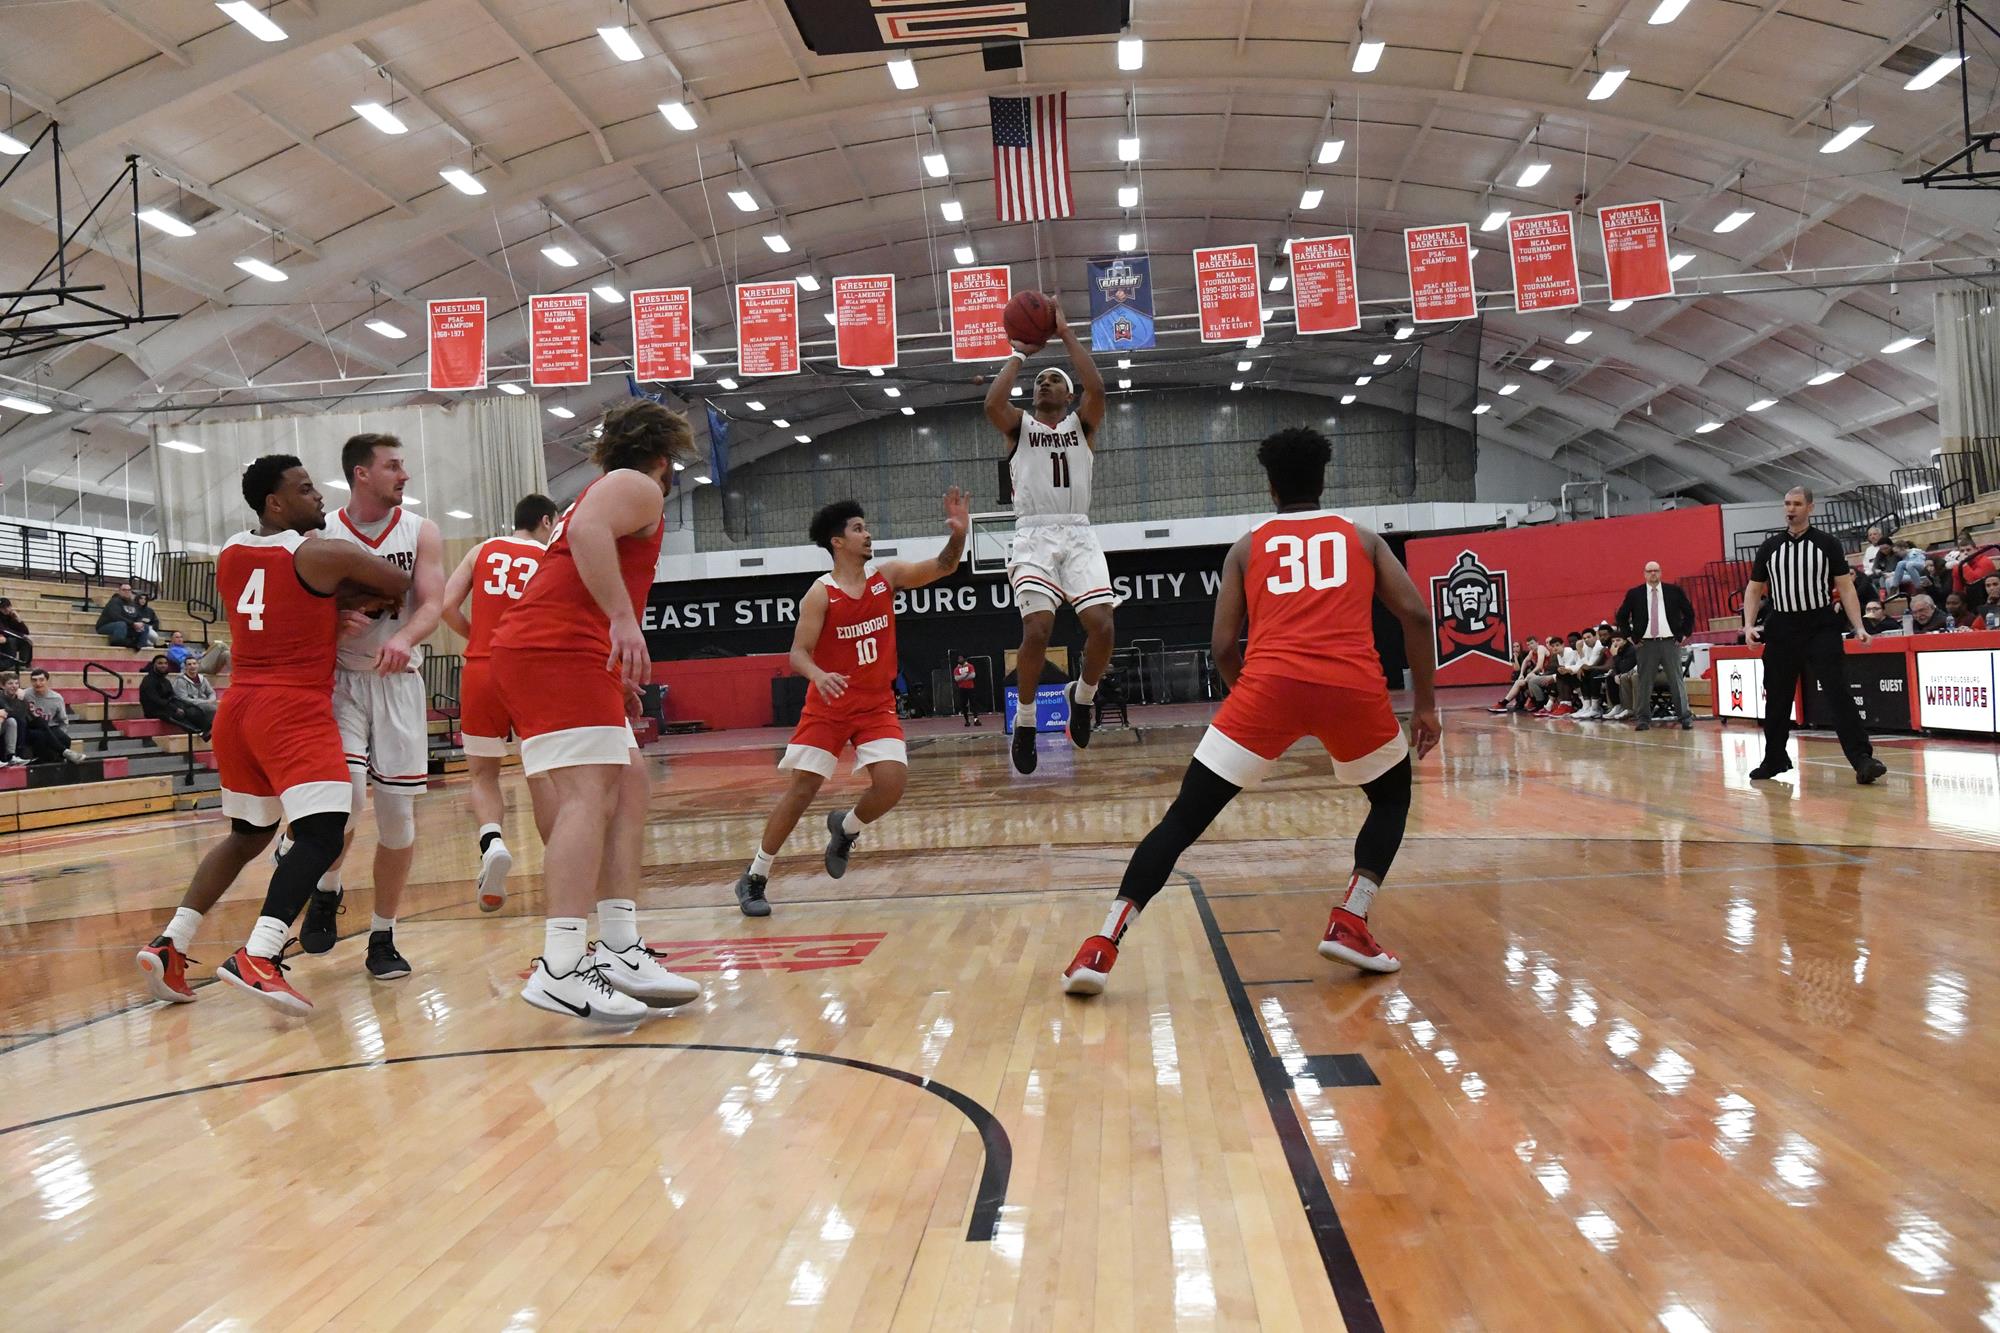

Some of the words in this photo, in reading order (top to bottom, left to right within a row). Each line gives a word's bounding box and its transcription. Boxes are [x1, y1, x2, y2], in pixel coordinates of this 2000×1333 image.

[1609, 208, 1649, 220] WOMEN'S
[1518, 220, 1558, 230] WOMEN'S
[1604, 215, 1659, 227] BASKETBALL
[1415, 231, 1455, 241] WOMEN'S
[1513, 226, 1568, 237] BASKETBALL
[1610, 227, 1657, 238] ALL-AMERICA
[1305, 244, 1333, 252] MEN'S
[1411, 237, 1465, 249] BASKETBALL
[1520, 244, 1566, 254] TOURNAMENT
[1210, 253, 1237, 261] MEN'S
[1295, 249, 1348, 260] BASKETBALL
[1200, 258, 1253, 269] BASKETBALL
[1421, 256, 1457, 265] CHAMPION
[1300, 261, 1345, 271] ALL-AMERICA
[964, 273, 990, 281] MEN'S
[1204, 277, 1251, 286] TOURNAMENT
[840, 281, 888, 289] WRESTLING
[953, 280, 1005, 289] BASKETBALL
[1240, 283, 1255, 291] 2012
[1523, 280, 1570, 290] TOURNAMENT
[743, 288, 790, 297] WRESTLING
[843, 291, 886, 299] ALL-AMERICA
[1415, 288, 1443, 296] REGULAR
[537, 299, 583, 308] WRESTLING
[638, 294, 685, 303] WRESTLING
[746, 299, 789, 307] ALL-AMERICA
[964, 296, 998, 304] CHAMPION
[434, 304, 480, 312] WRESTLING
[1050, 451, 1070, 488] 11
[1265, 531, 1348, 595] 30
[483, 552, 539, 600] 33
[236, 568, 265, 631] 4
[641, 602, 720, 631] EAST
[836, 614, 889, 639] EDINBORO
[855, 637, 878, 666] 10
[1879, 679, 1903, 692] GUEST
[1925, 685, 1988, 708] WARRIORS
